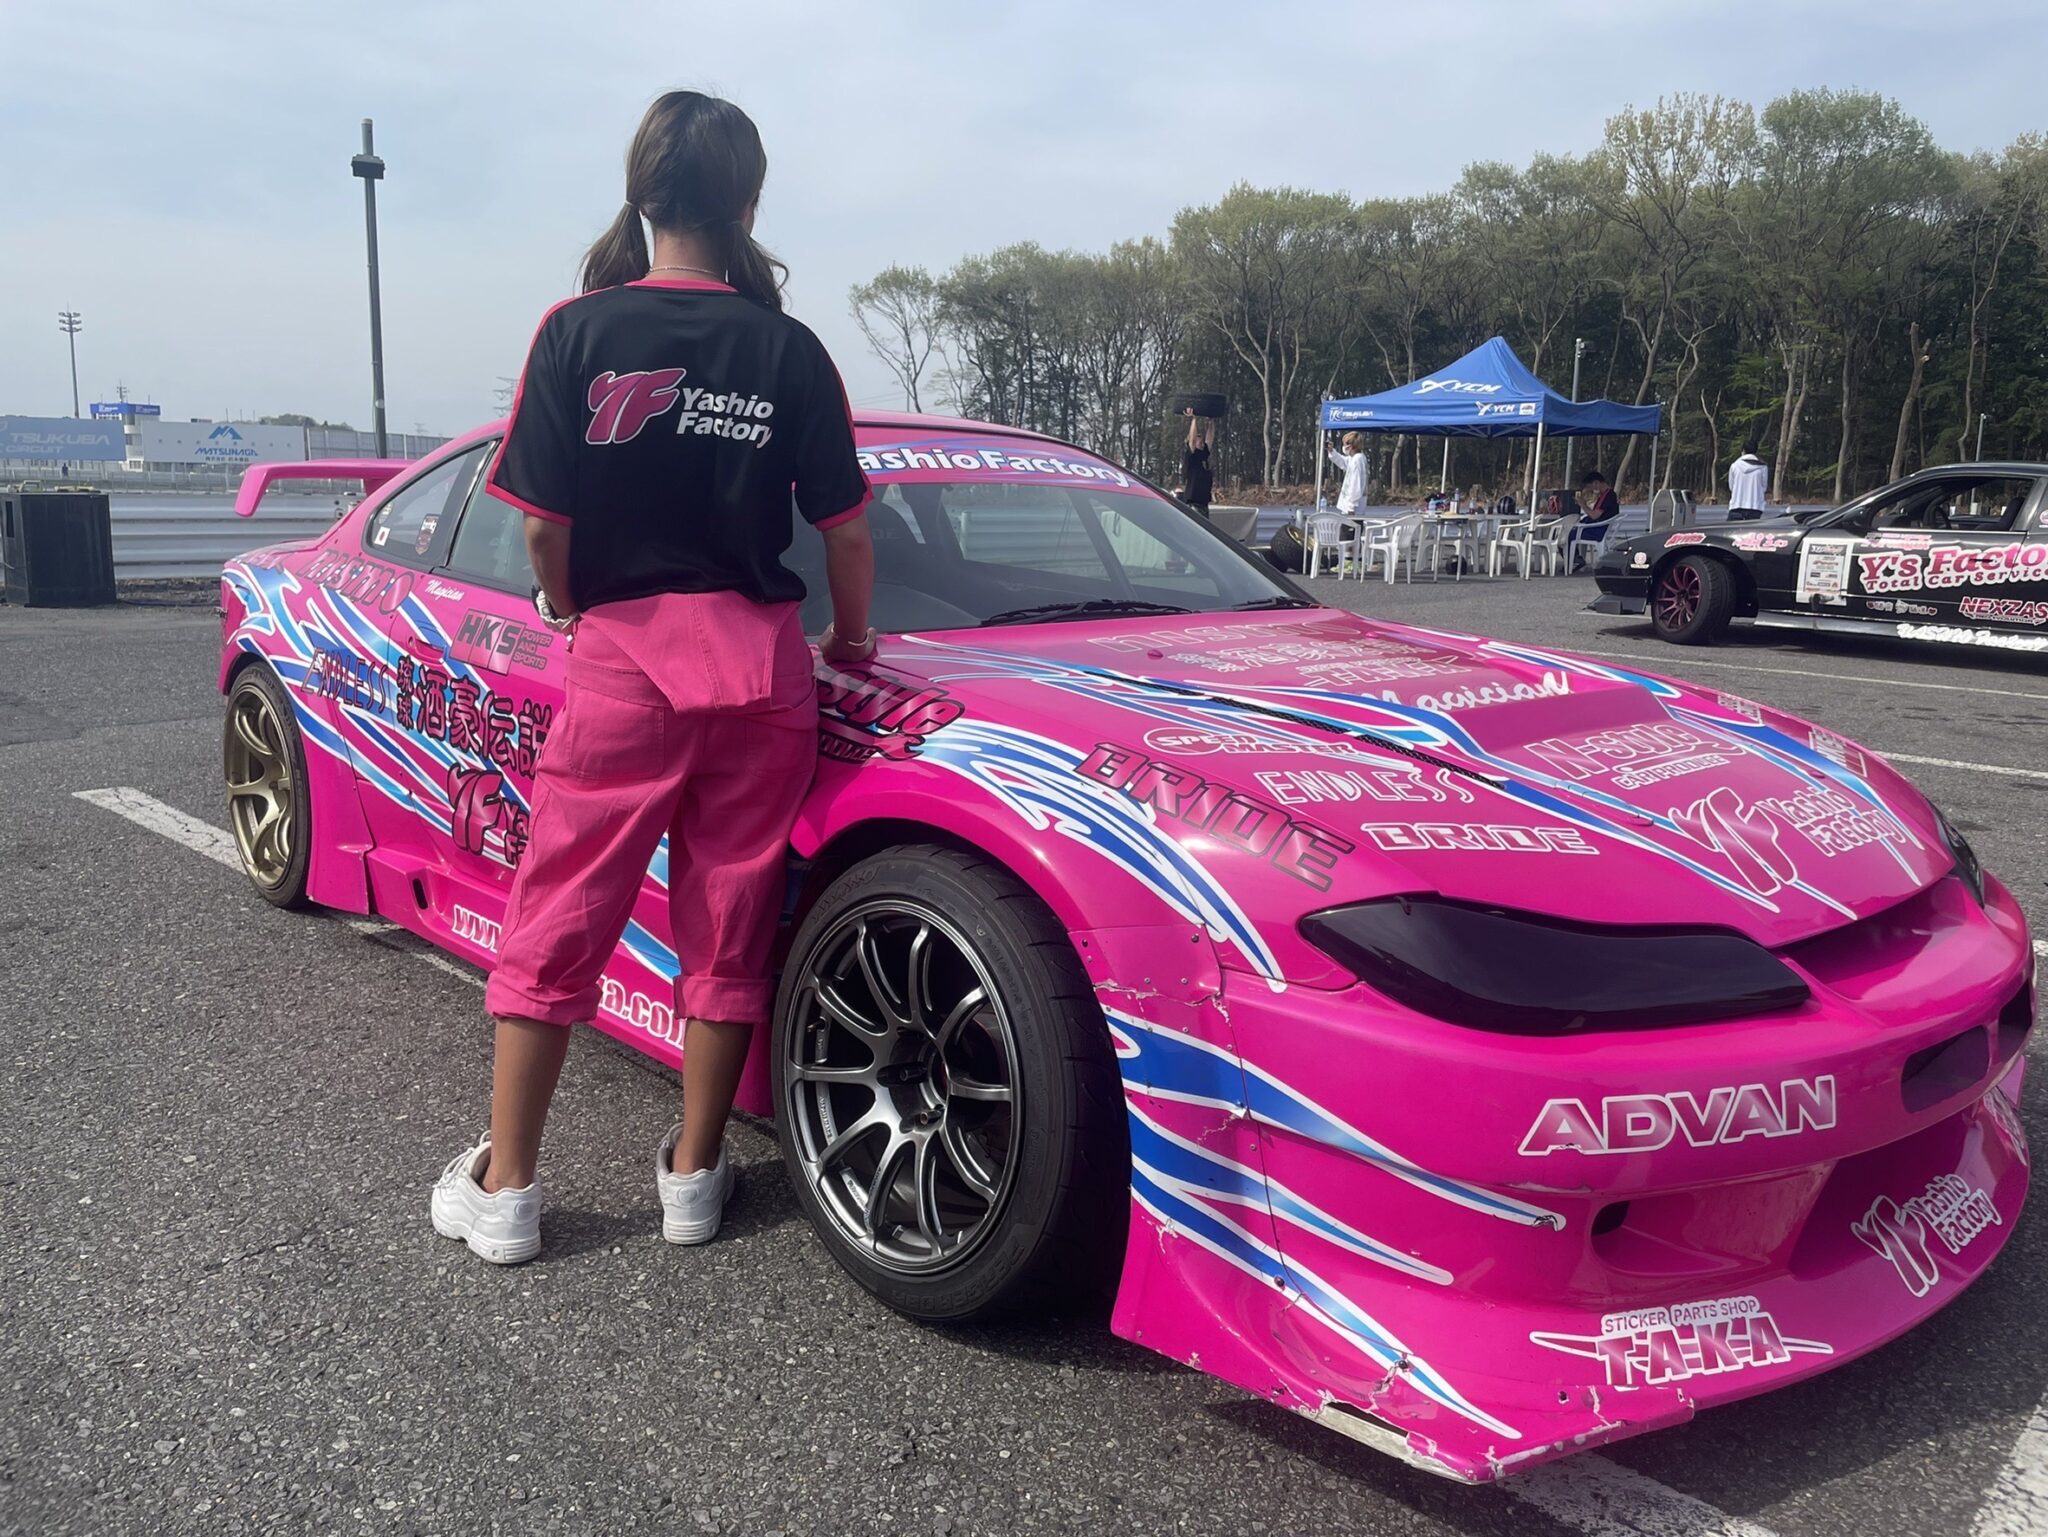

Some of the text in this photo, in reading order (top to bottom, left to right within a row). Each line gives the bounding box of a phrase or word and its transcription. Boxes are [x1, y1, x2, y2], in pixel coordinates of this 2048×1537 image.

[682, 388, 774, 420] Yashio
[9, 432, 111, 446] TSUKUBA
[676, 412, 773, 449] Factory
[6, 444, 65, 454] CIRCUIT
[194, 447, 259, 457] MATSUNAGA
[1861, 555, 1919, 581] Y's
[1928, 545, 2048, 576] Facto
[1866, 576, 1920, 591] Total
[1928, 575, 1964, 586] Car
[456, 613, 522, 656] HKS
[517, 640, 537, 653] AND
[521, 629, 553, 648] POWER
[512, 651, 548, 670] SPORTS
[300, 647, 389, 714] ENDLESS
[1156, 734, 1258, 747] SPEED
[1220, 741, 1358, 754] MASTER
[1252, 766, 1474, 804] ENDLESS
[1074, 742, 1357, 893] BRIDE
[1754, 786, 1857, 829] Yashio
[1361, 822, 1601, 855] BRIDE
[1796, 809, 1907, 857] Factory
[1517, 1075, 1836, 1157] ADVAN
[1902, 1174, 1972, 1224] Yashio
[1933, 1188, 2003, 1254] Factory
[1604, 1299, 1758, 1333] STICKER PARTS SHOP
